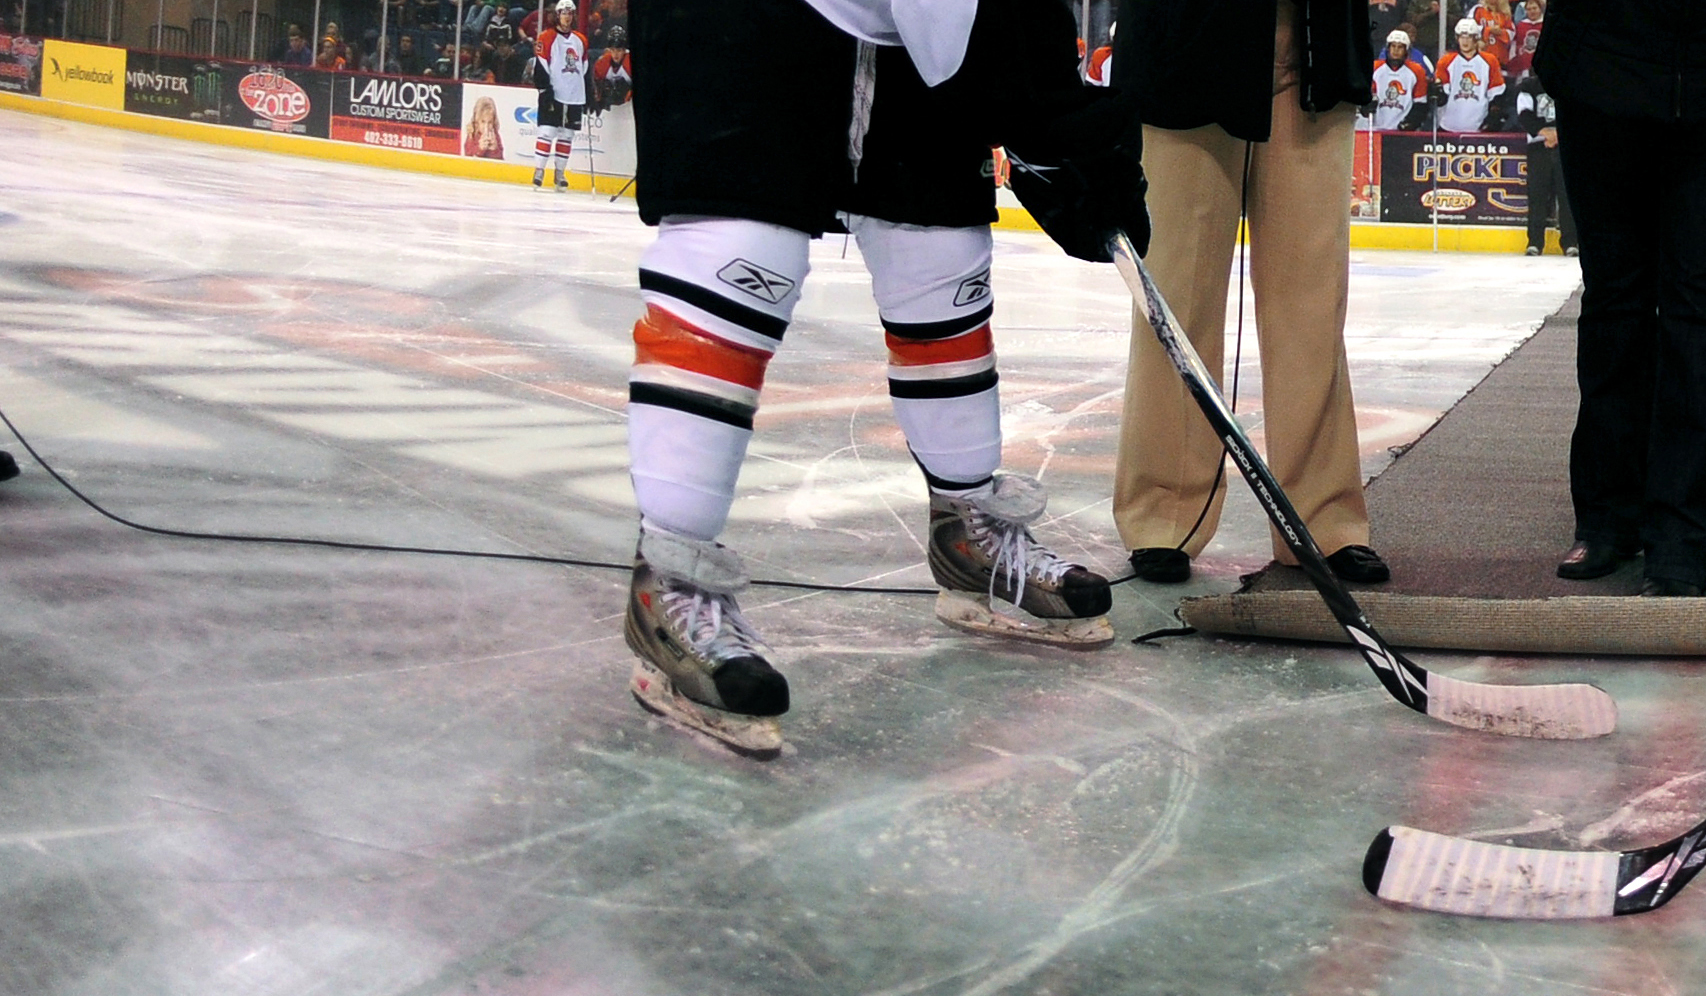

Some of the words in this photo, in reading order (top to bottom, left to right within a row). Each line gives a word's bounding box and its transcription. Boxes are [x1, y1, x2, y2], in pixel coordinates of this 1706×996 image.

[64, 65, 114, 85] yellowbook
[134, 93, 179, 105] ENERGY
[252, 90, 307, 117] zone
[350, 77, 442, 112] LAWLOR'S
[350, 104, 384, 116] CUSTOM
[386, 107, 442, 124] SPORTSWEAR
[1424, 142, 1509, 154] nebraska
[1415, 155, 1497, 180] PICK
[1257, 481, 1302, 547] TECHNOLOGY
